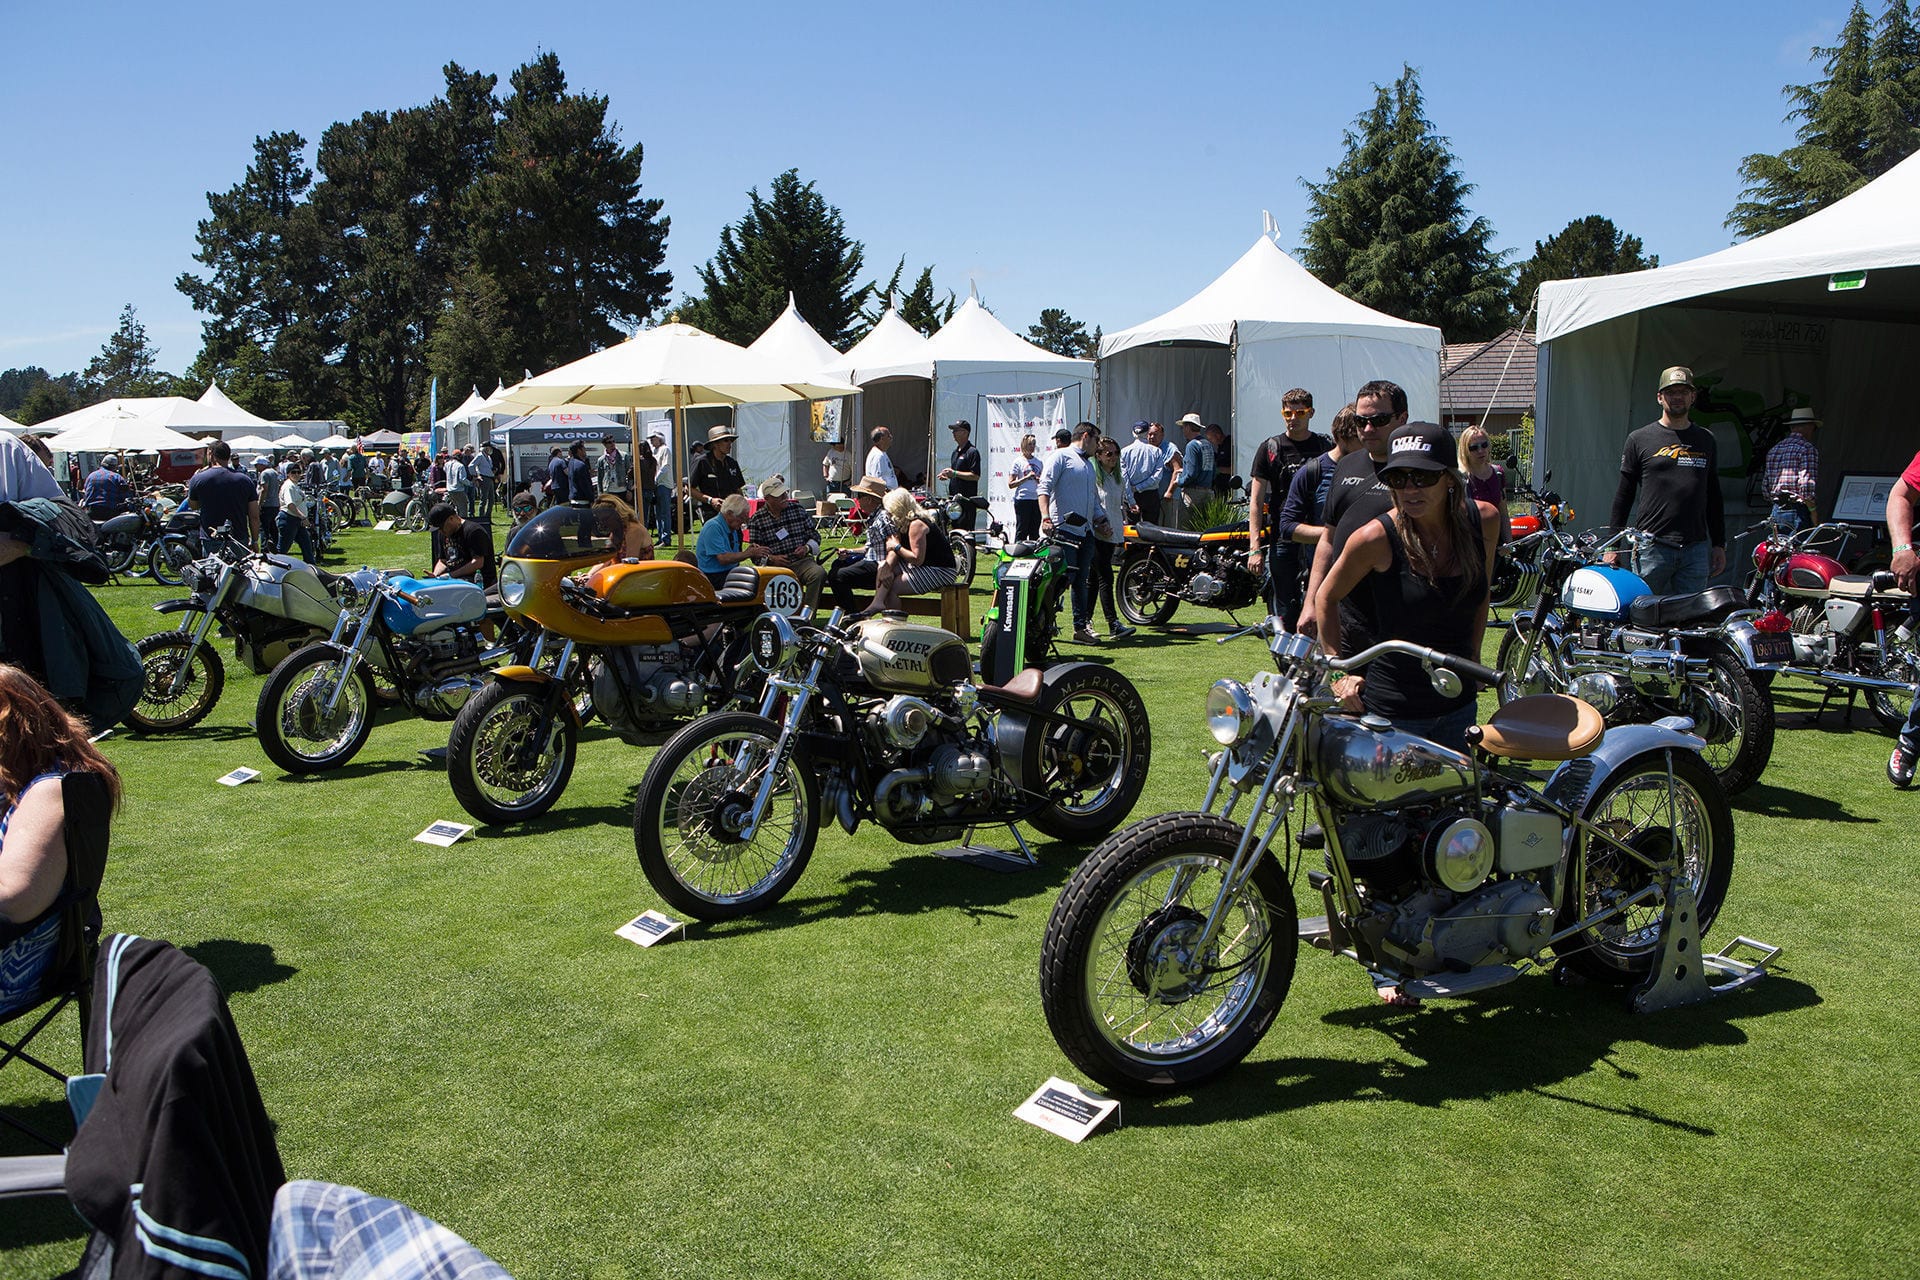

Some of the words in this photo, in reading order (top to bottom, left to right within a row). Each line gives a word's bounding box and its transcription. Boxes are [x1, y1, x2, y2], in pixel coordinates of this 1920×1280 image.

[768, 580, 800, 610] 163
[1003, 586, 1015, 632] Kawasaki
[886, 639, 931, 658] BOXER
[884, 656, 927, 673] METAL
[776, 735, 795, 774] BMW
